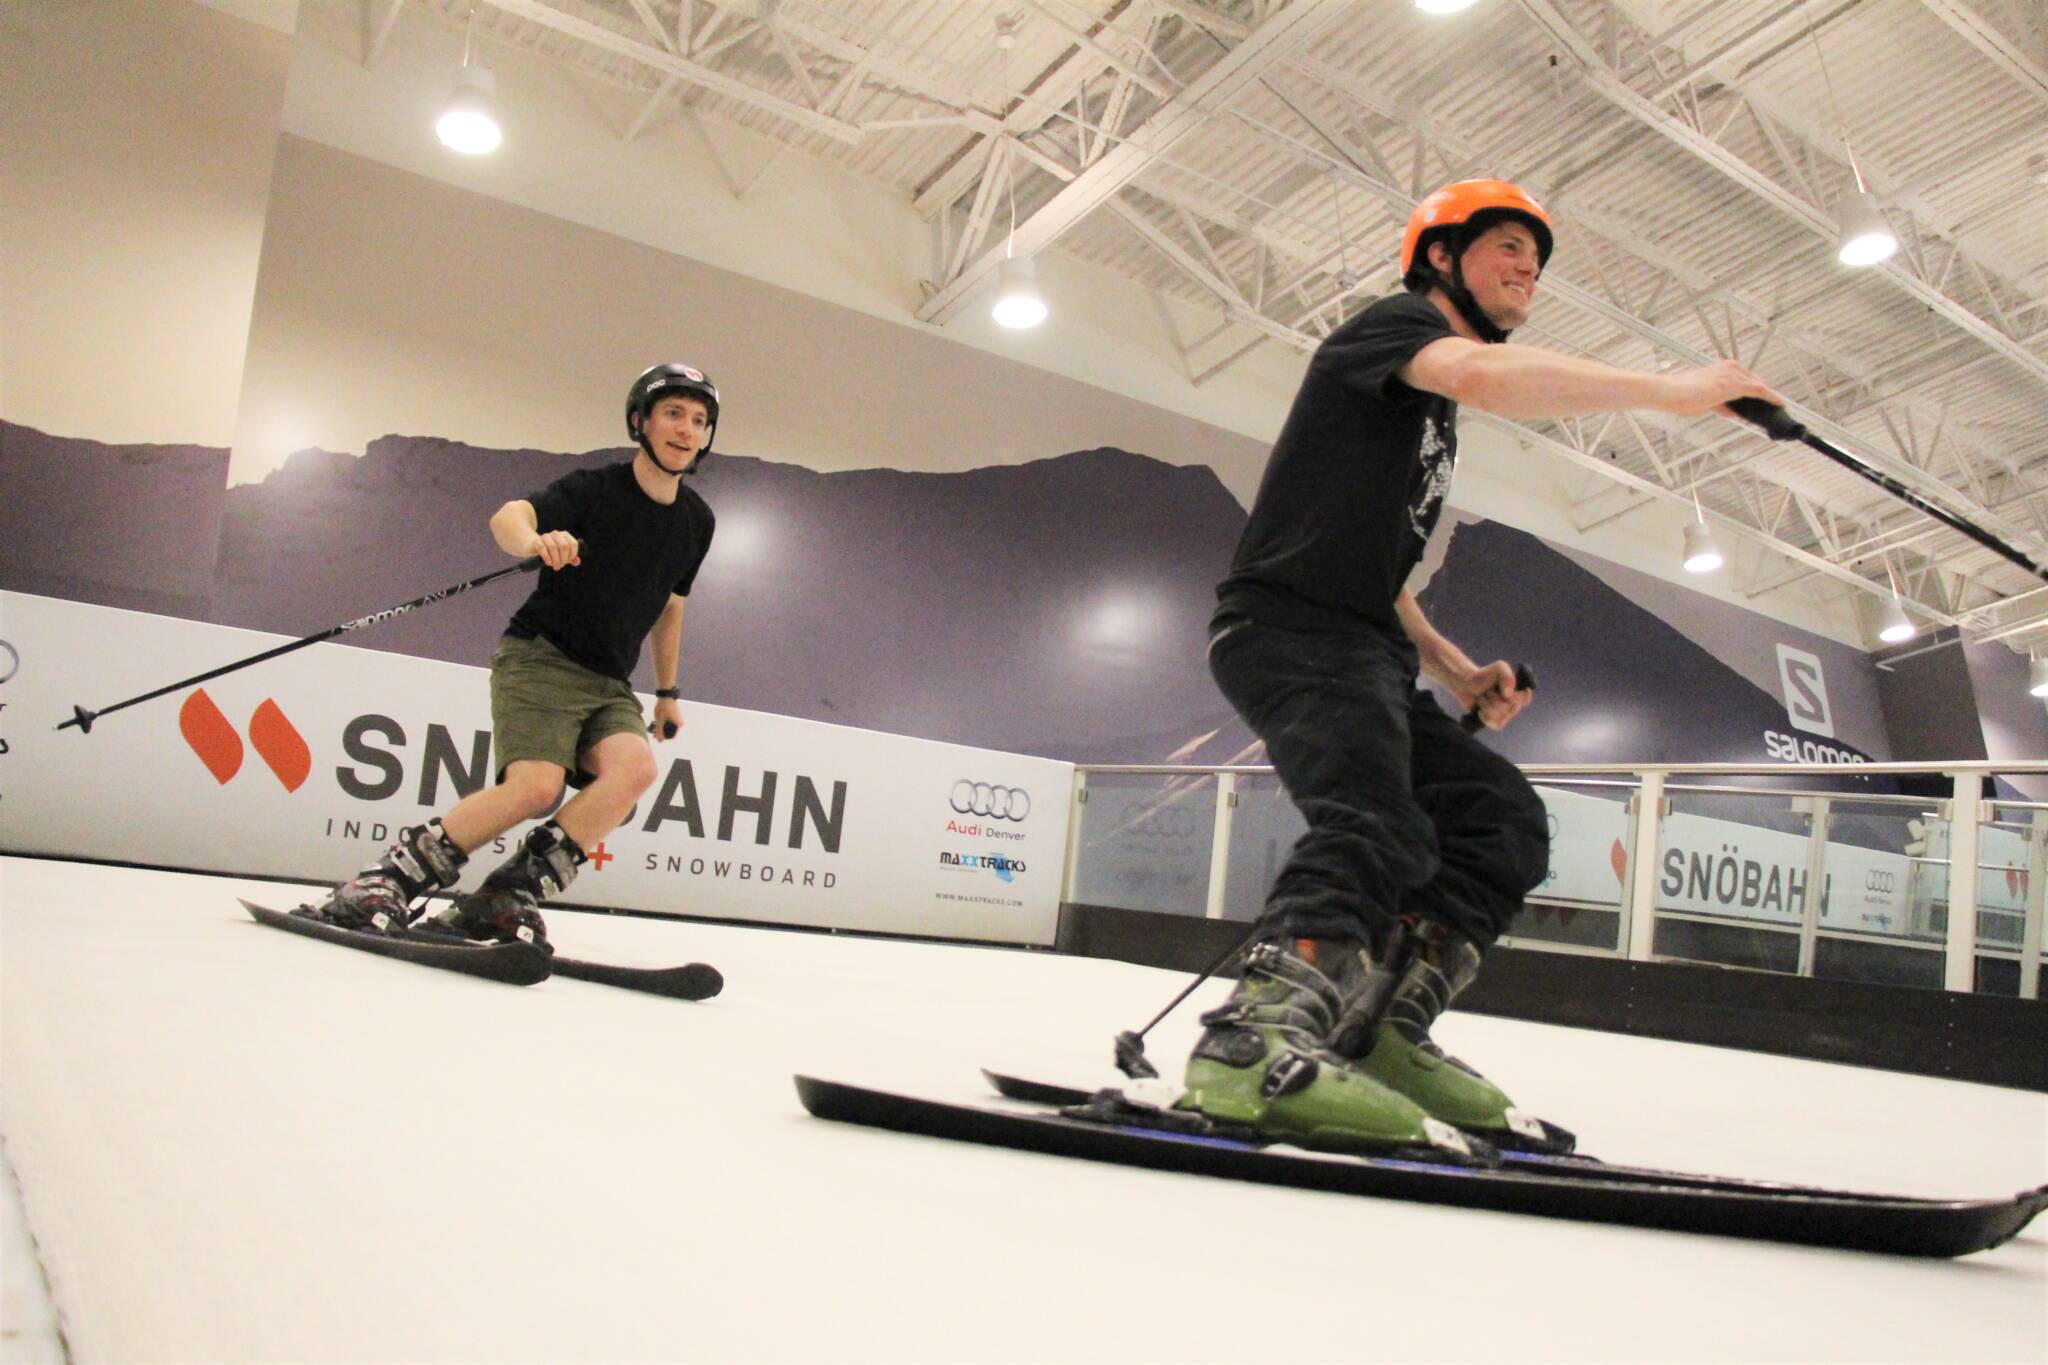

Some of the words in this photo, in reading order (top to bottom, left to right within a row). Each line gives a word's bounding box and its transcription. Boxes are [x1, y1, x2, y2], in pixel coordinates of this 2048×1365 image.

[335, 714, 848, 854] SNAHN
[946, 821, 982, 836] Audi
[986, 828, 1025, 841] Denver
[645, 853, 837, 889] SNOWBOARD
